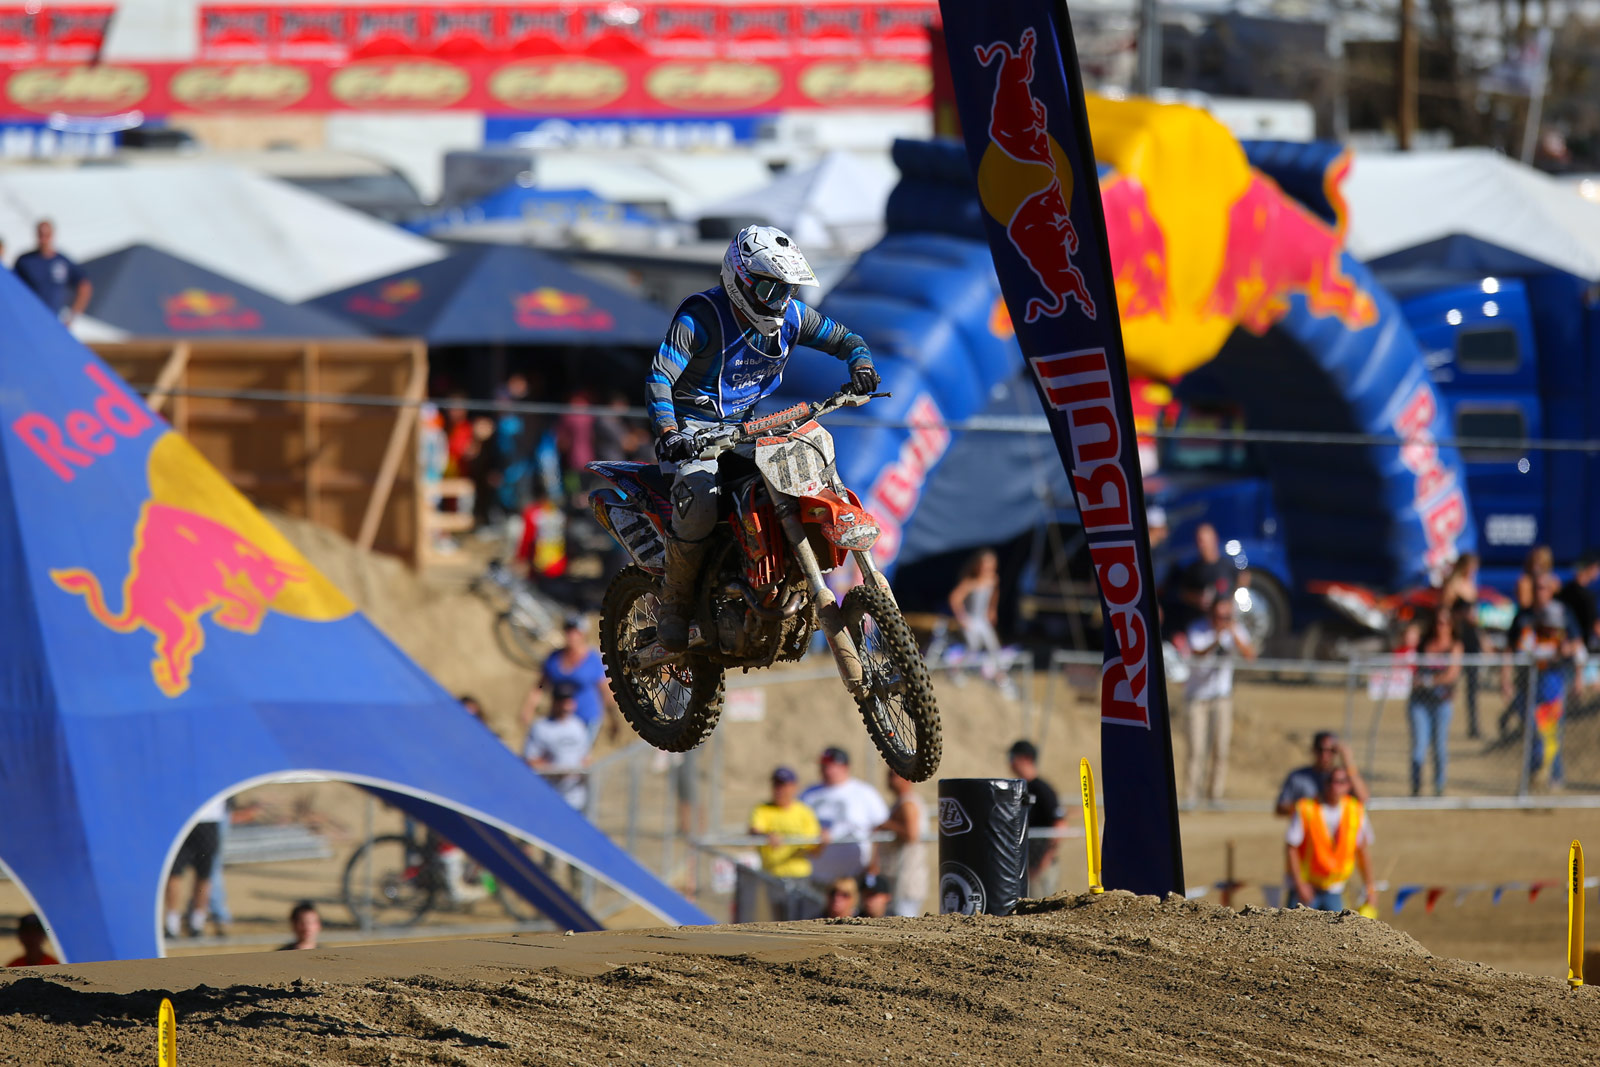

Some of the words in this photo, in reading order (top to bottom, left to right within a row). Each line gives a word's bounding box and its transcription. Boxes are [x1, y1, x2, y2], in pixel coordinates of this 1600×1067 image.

[735, 358, 749, 366] Red
[750, 357, 763, 365] Bull
[749, 407, 805, 431] RENTHAL
[12, 362, 154, 483] Red
[1030, 347, 1133, 533] Bull
[1089, 540, 1151, 730] Red
